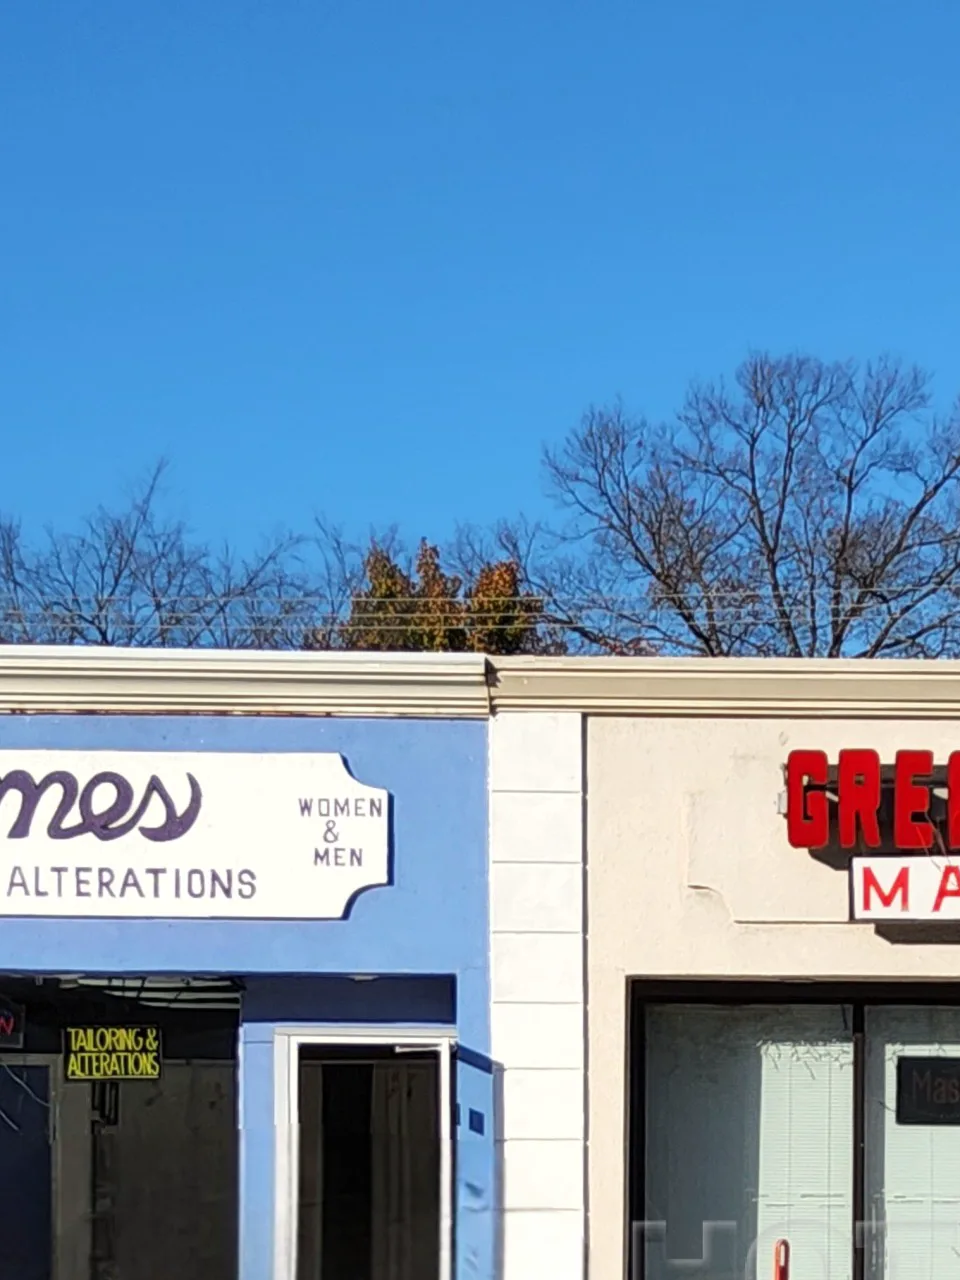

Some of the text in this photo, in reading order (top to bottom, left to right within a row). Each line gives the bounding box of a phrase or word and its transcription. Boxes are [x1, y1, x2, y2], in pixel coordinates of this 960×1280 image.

[298, 798, 382, 817] WOMEN
[322, 820, 339, 843] &
[313, 847, 363, 867] MEN
[7, 866, 257, 900] ALTERATIONS
[67, 1027, 159, 1051] TAILORING &
[67, 1052, 160, 1076] ALTERATIONS
